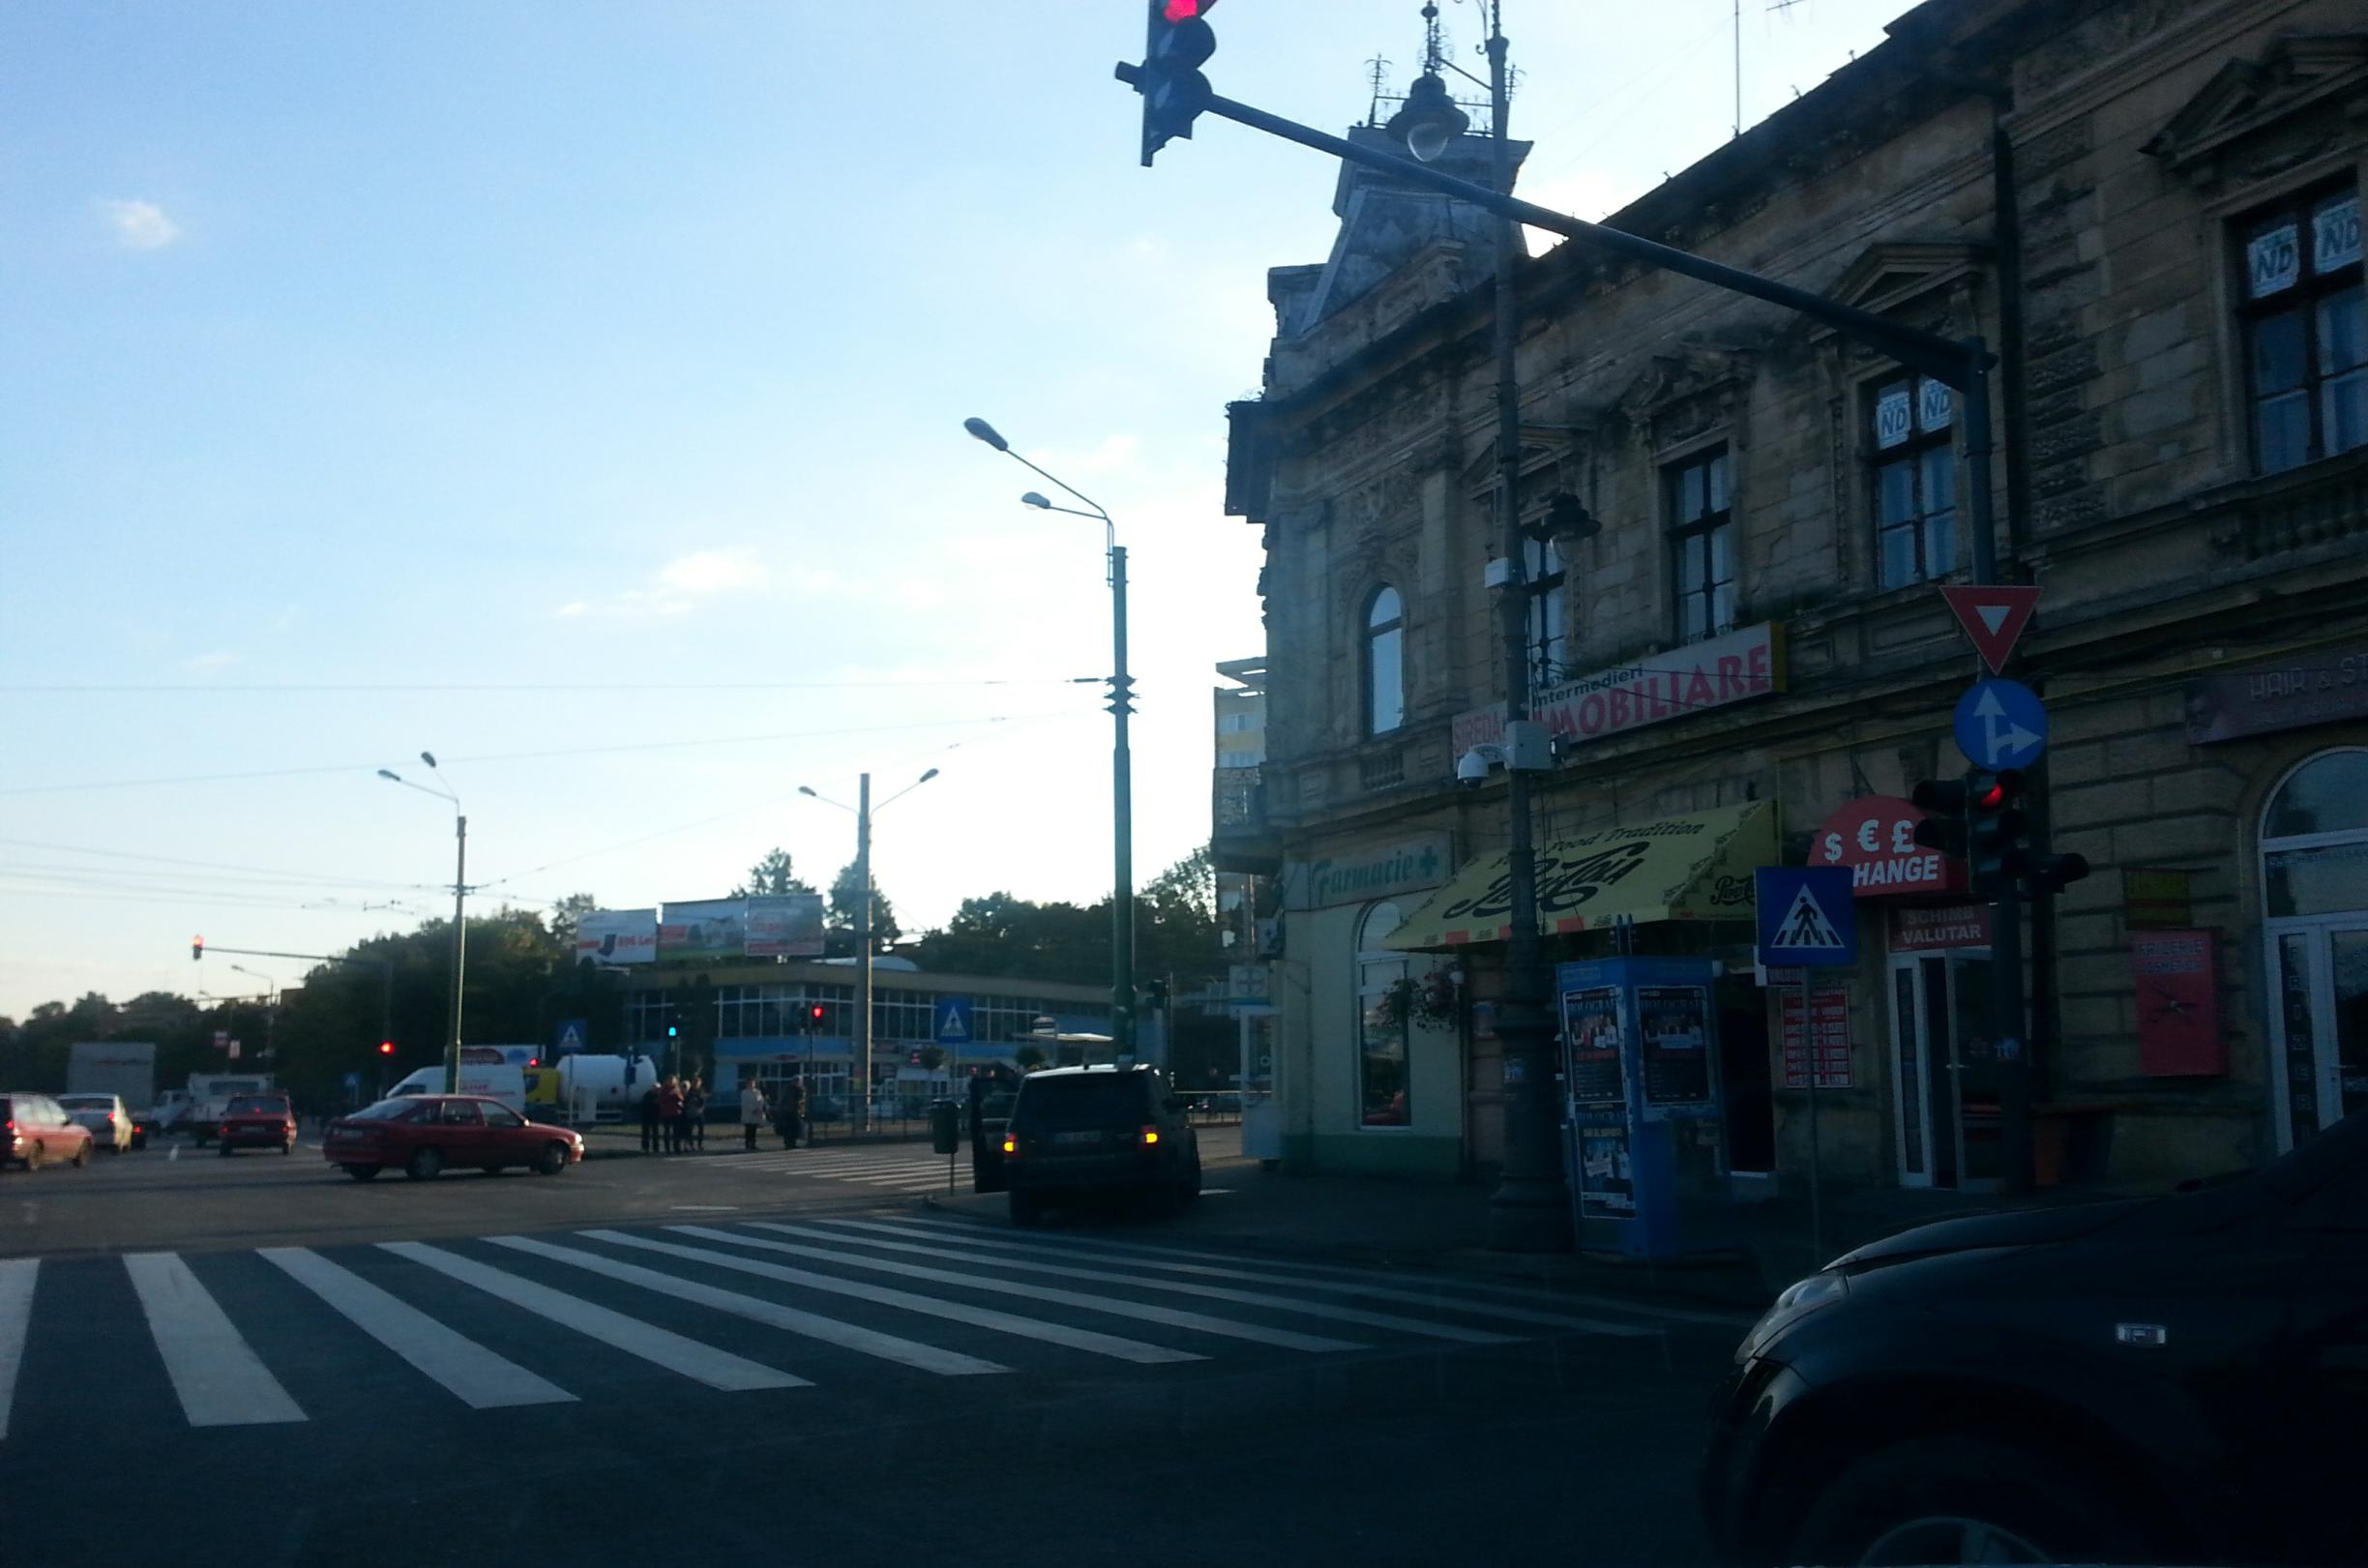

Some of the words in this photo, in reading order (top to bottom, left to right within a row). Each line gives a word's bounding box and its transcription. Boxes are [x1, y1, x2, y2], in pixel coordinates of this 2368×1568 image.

[1606, 821, 1704, 843] Tradition
[1824, 832, 1843, 863] $
[1857, 819, 1880, 852] €
[1891, 820, 1915, 853] £
[1312, 850, 1413, 906] Farmacie
[1852, 855, 1939, 888] HANGE
[1903, 925, 1982, 945] VALUTAR
